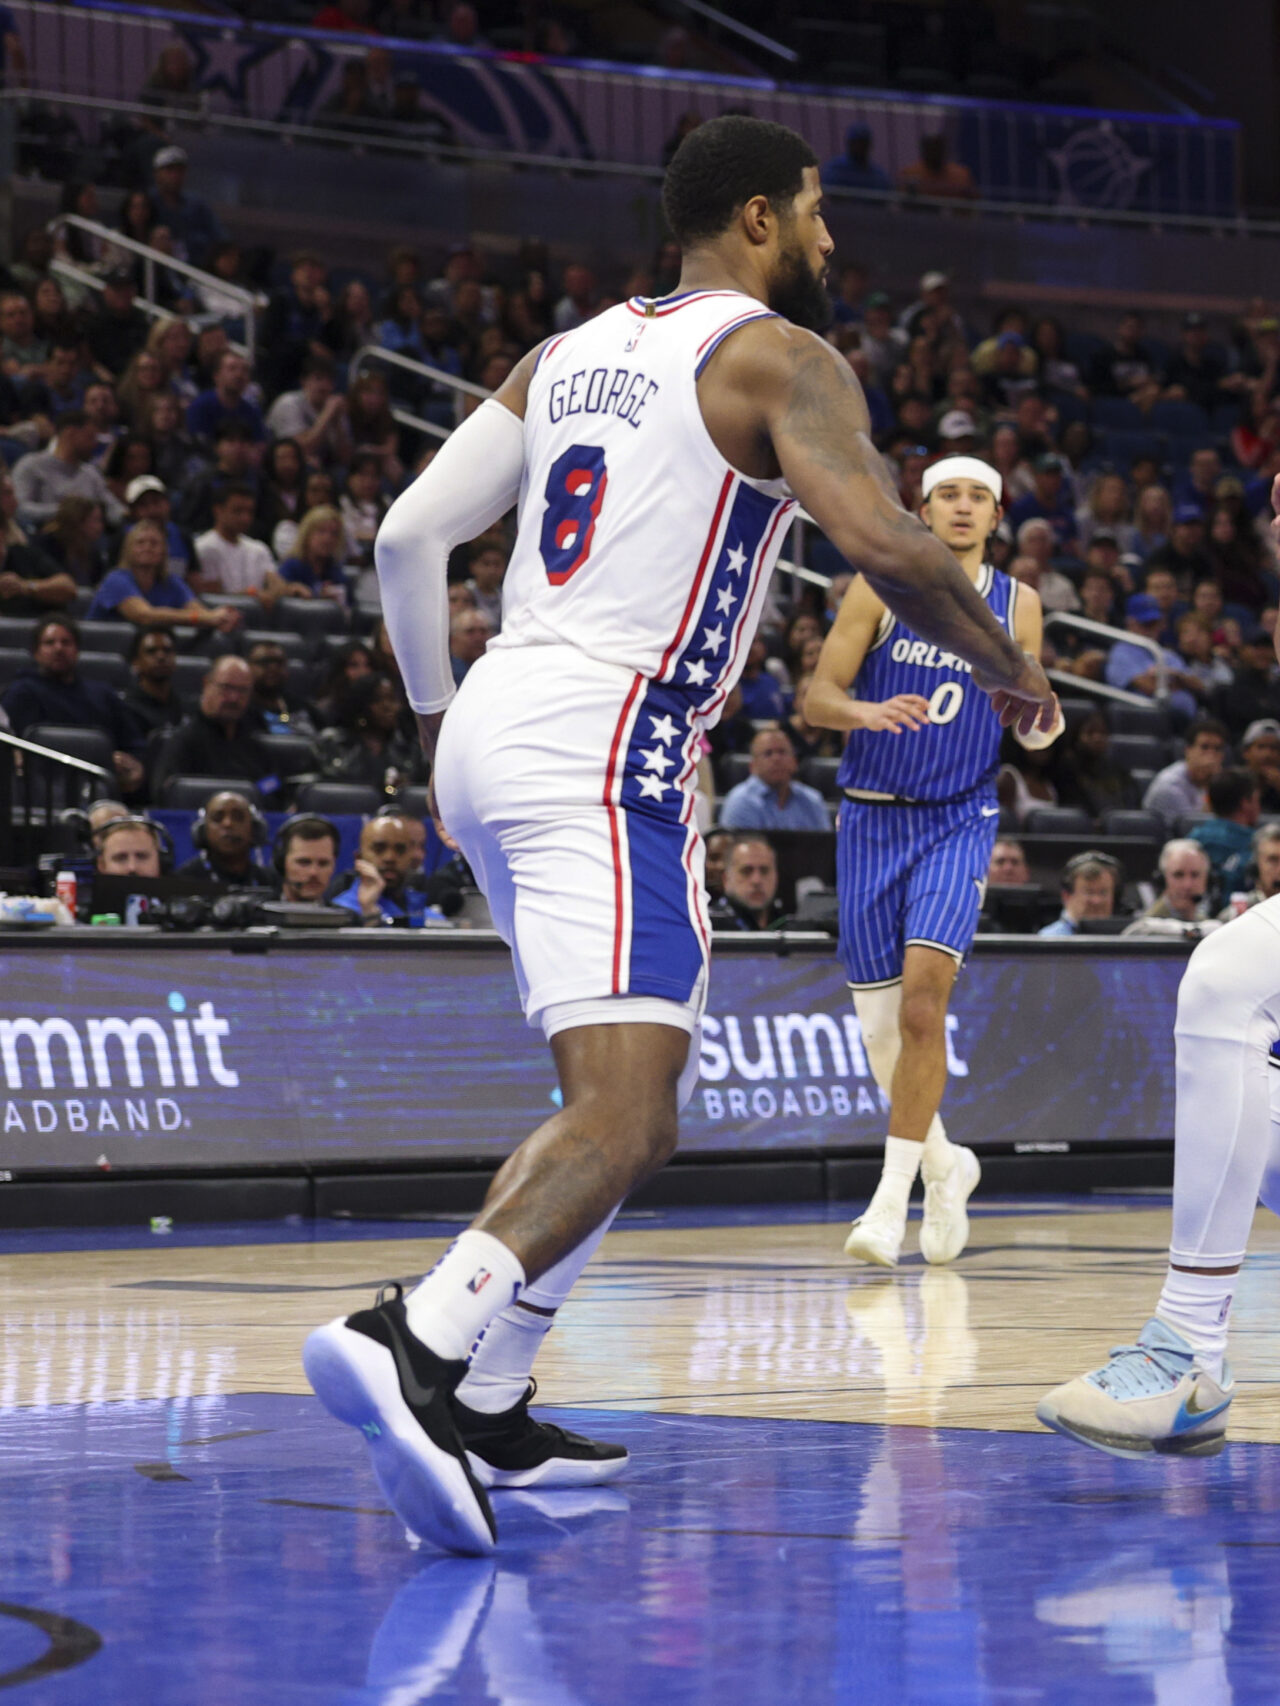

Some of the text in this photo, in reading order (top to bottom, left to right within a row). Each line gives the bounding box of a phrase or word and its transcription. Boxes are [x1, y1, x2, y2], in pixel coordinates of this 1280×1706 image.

[549, 368, 659, 429] GEORGE
[539, 444, 608, 586] 8
[926, 681, 964, 725] 0
[0, 991, 240, 1089] mmit
